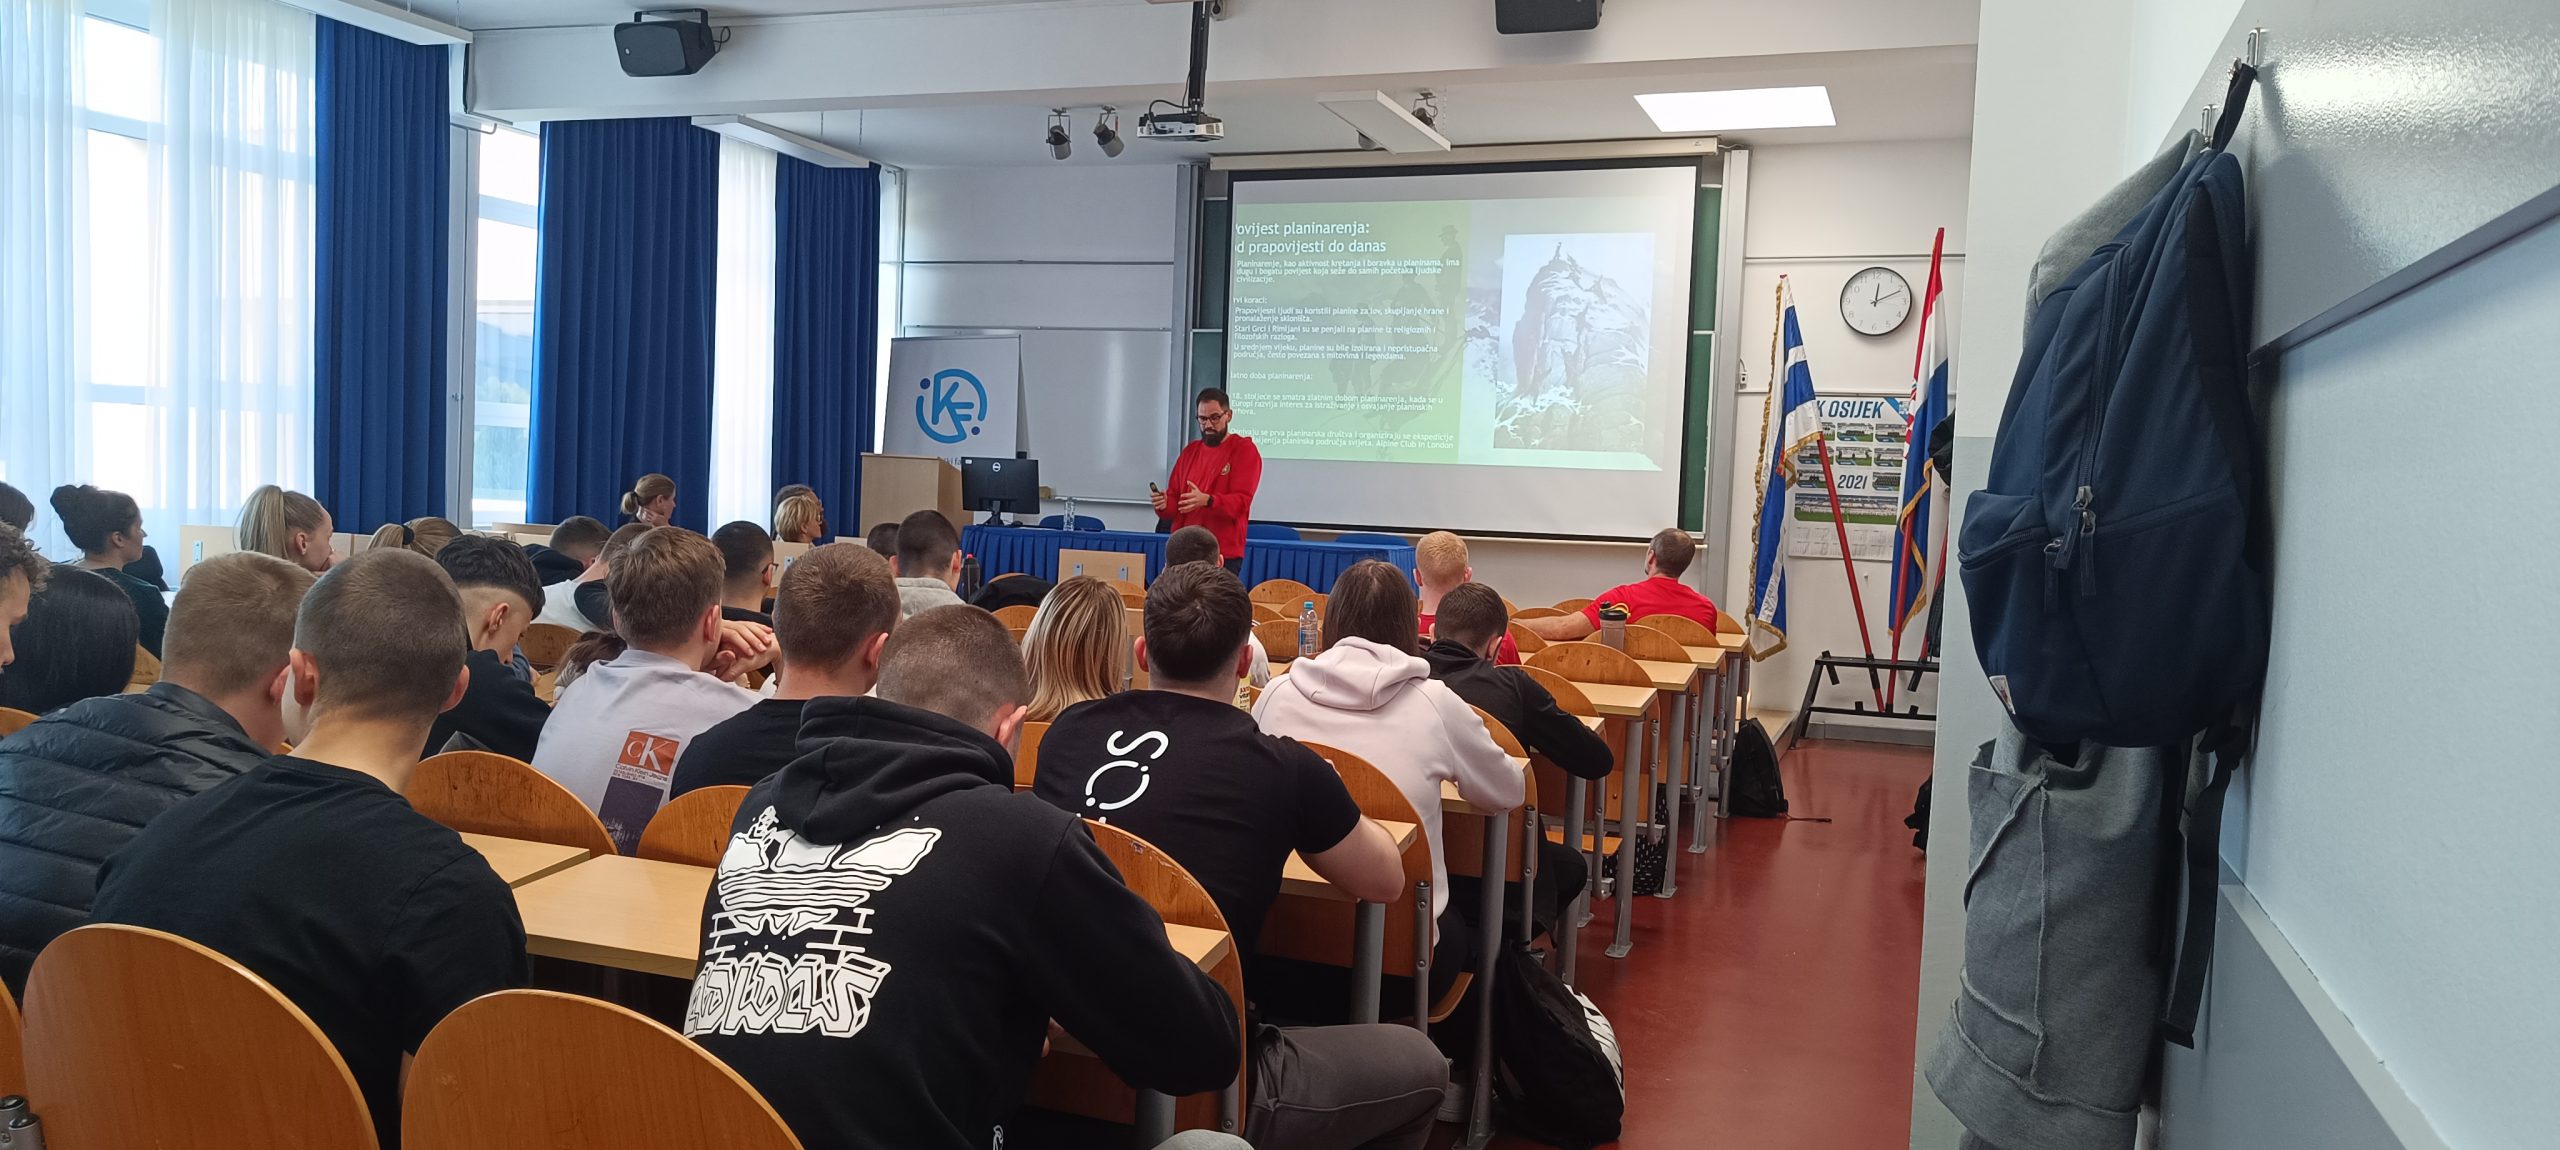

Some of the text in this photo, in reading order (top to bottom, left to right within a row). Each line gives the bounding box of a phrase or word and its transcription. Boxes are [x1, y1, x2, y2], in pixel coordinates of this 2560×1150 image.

[1236, 221, 1370, 237] ovijest planinarenja:
[1235, 240, 1386, 256] d prapovijesti do danas
[1283, 259, 1296, 267] kao
[1298, 259, 1329, 267] aktivnost
[1330, 259, 1360, 269] kretanja
[1367, 259, 1395, 267] boravka
[1403, 258, 1443, 268] planinama,
[1445, 258, 1460, 266] ima
[1237, 267, 1253, 276] dugu
[1259, 267, 1282, 276] bogatu
[1284, 267, 1311, 276] povijest
[1313, 267, 1328, 276] koja
[1380, 266, 1413, 276] početaka
[1415, 266, 1441, 275] ljudske
[1277, 306, 1293, 316] ljudi
[1332, 307, 1358, 316] planine
[1370, 307, 1382, 316] lov,
[1384, 307, 1421, 316] skupljanje
[1272, 325, 1300, 334] Rimljani
[1320, 325, 1345, 334] penjali
[1357, 325, 1383, 334] planine
[1393, 325, 1431, 334] religioznih
[1270, 333, 1297, 342] razloga.
[1240, 343, 1272, 352] srednjem
[1274, 343, 1297, 352] vijeku,
[1298, 344, 1324, 353] planine
[1234, 351, 1265, 360] područja,
[1365, 352, 1406, 361] legendama.
[1243, 392, 1270, 402] stoljeće
[1232, 399, 1252, 408] Europi
[1254, 400, 1277, 409] razvija
[1361, 402, 1394, 411] osvajanje
[1396, 403, 1432, 412] planinskih
[1828, 400, 1884, 418] OSIJEK
[1837, 475, 1868, 489] 2021
